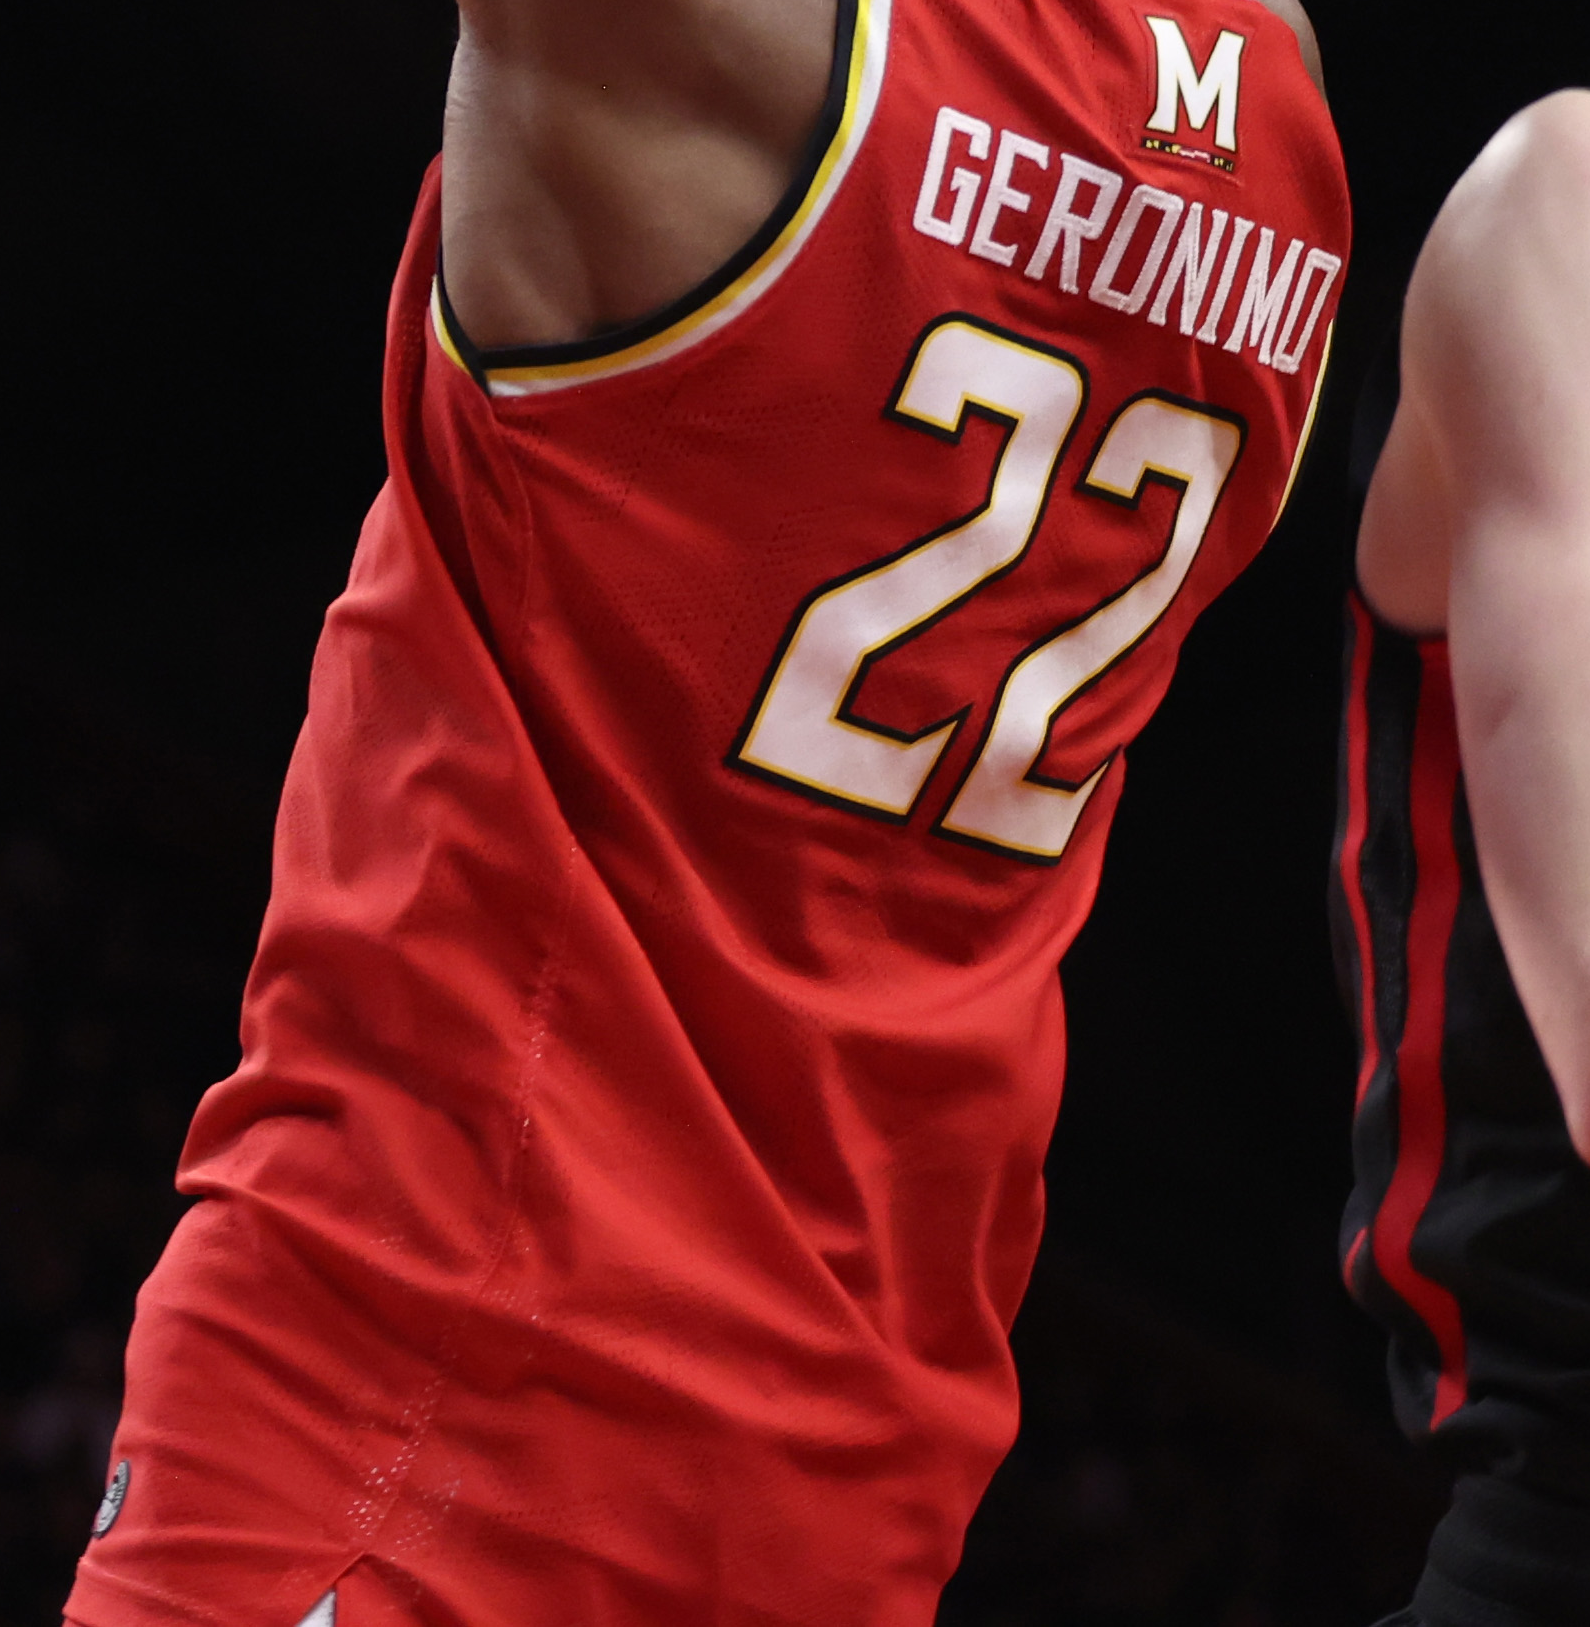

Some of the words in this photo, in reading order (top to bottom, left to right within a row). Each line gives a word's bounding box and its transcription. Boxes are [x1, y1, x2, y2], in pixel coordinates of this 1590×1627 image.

[1145, 15, 1247, 154] M
[912, 106, 1341, 374] GERONIMO
[725, 311, 1248, 865] 22
